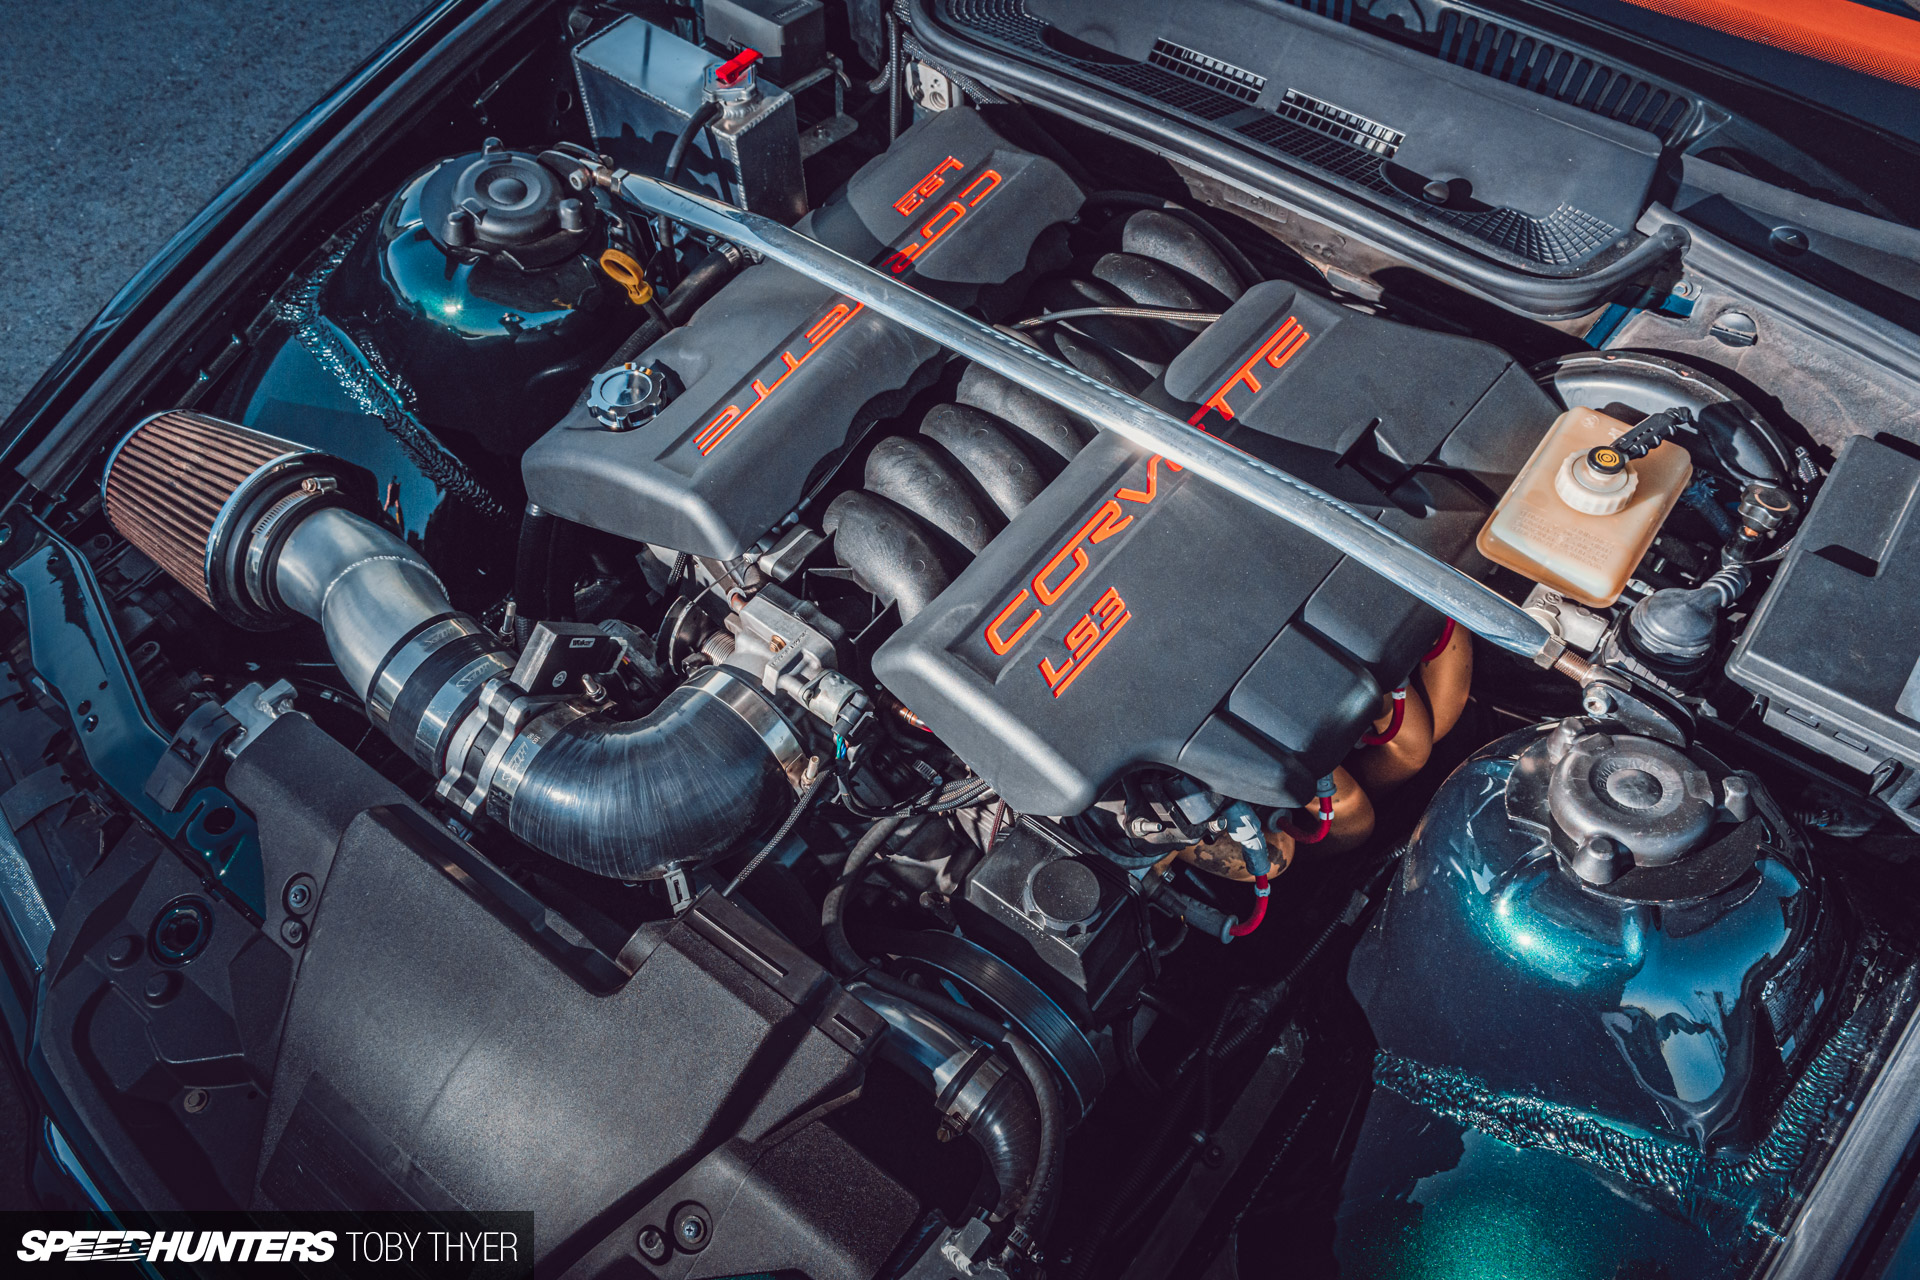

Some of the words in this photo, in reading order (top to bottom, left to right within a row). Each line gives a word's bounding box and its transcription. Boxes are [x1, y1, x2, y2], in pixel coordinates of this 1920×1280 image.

[895, 156, 965, 217] LS3
[693, 169, 1003, 457] CORETTE
[1038, 586, 1129, 692] LS3
